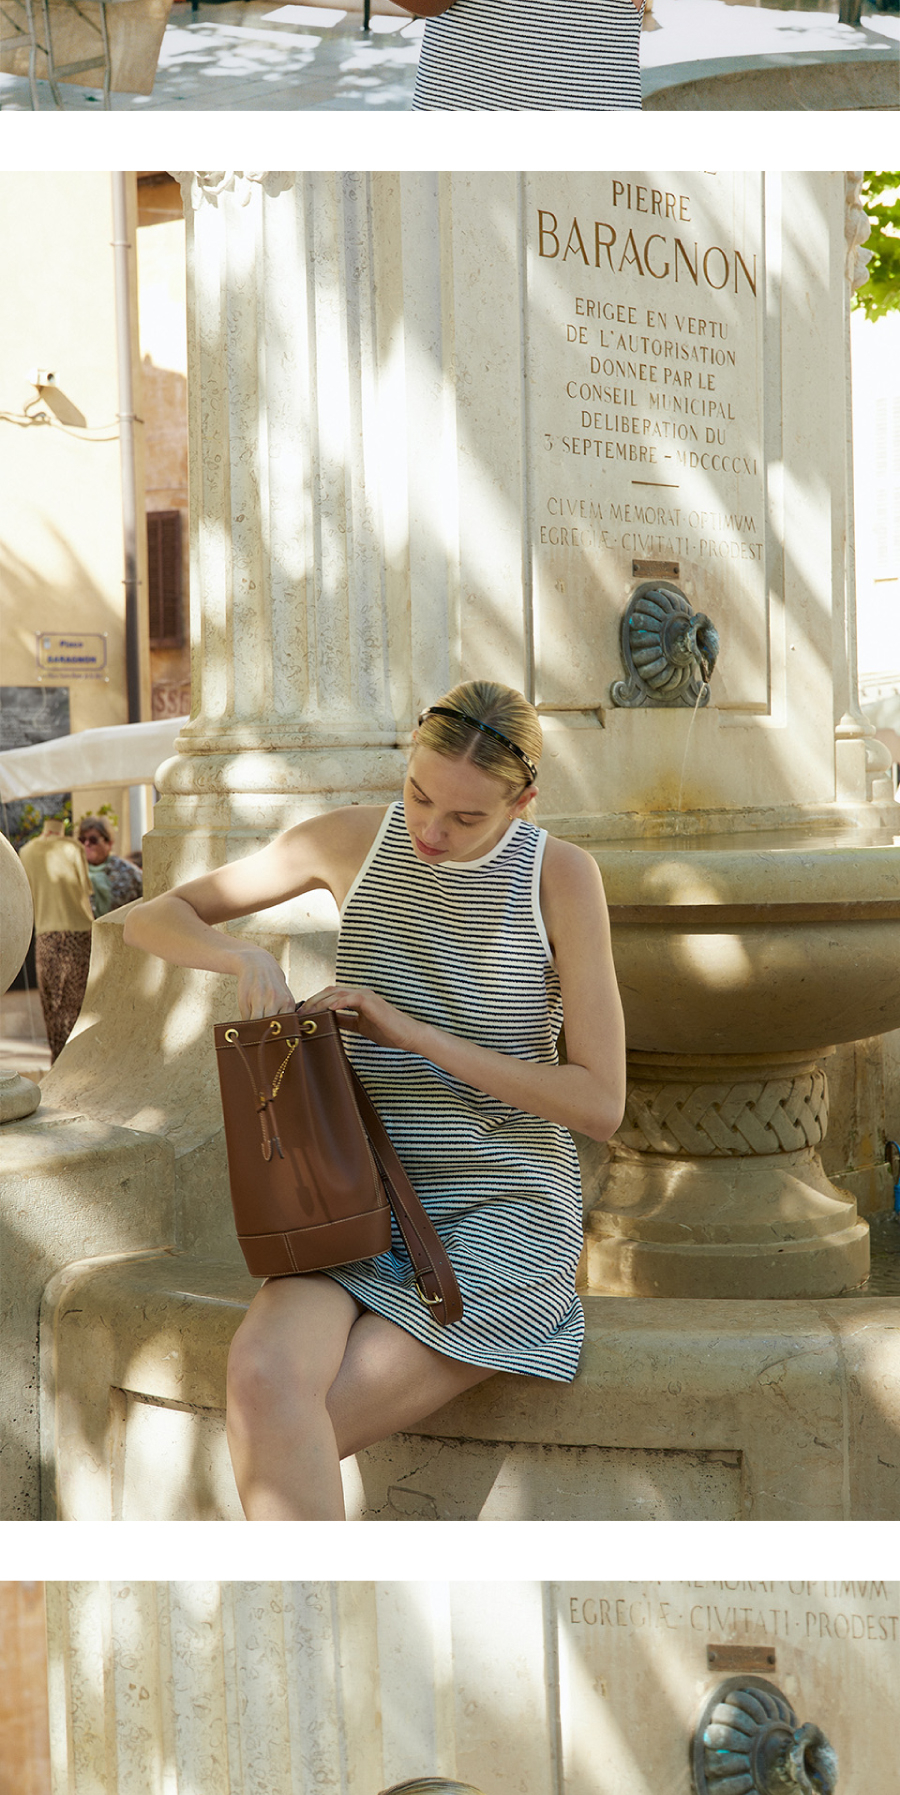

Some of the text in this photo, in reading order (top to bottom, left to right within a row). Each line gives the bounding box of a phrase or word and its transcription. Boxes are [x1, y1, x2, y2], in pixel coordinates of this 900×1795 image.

[612, 179, 692, 223] PIERRE
[537, 209, 758, 298] BARAGNON
[575, 297, 729, 340] ERIGEE EN VERTU
[566, 324, 737, 367] DE L'AUTORISATION
[590, 356, 716, 391] DONNEE PAR LE
[566, 380, 736, 421] CONSEIL MUNICIPAL
[581, 410, 726, 446] DELIBERATION DU
[544, 434, 553, 451] 3
[562, 436, 658, 464] SEPTEMBRE
[547, 496, 603, 520] CIVEM
[610, 503, 681, 526] MEMORAT
[621, 533, 689, 556] CIVITATI
[699, 539, 764, 561] PRODEST
[690, 1605, 790, 1636] CIVITATI
[806, 1611, 900, 1641] PRODEST
